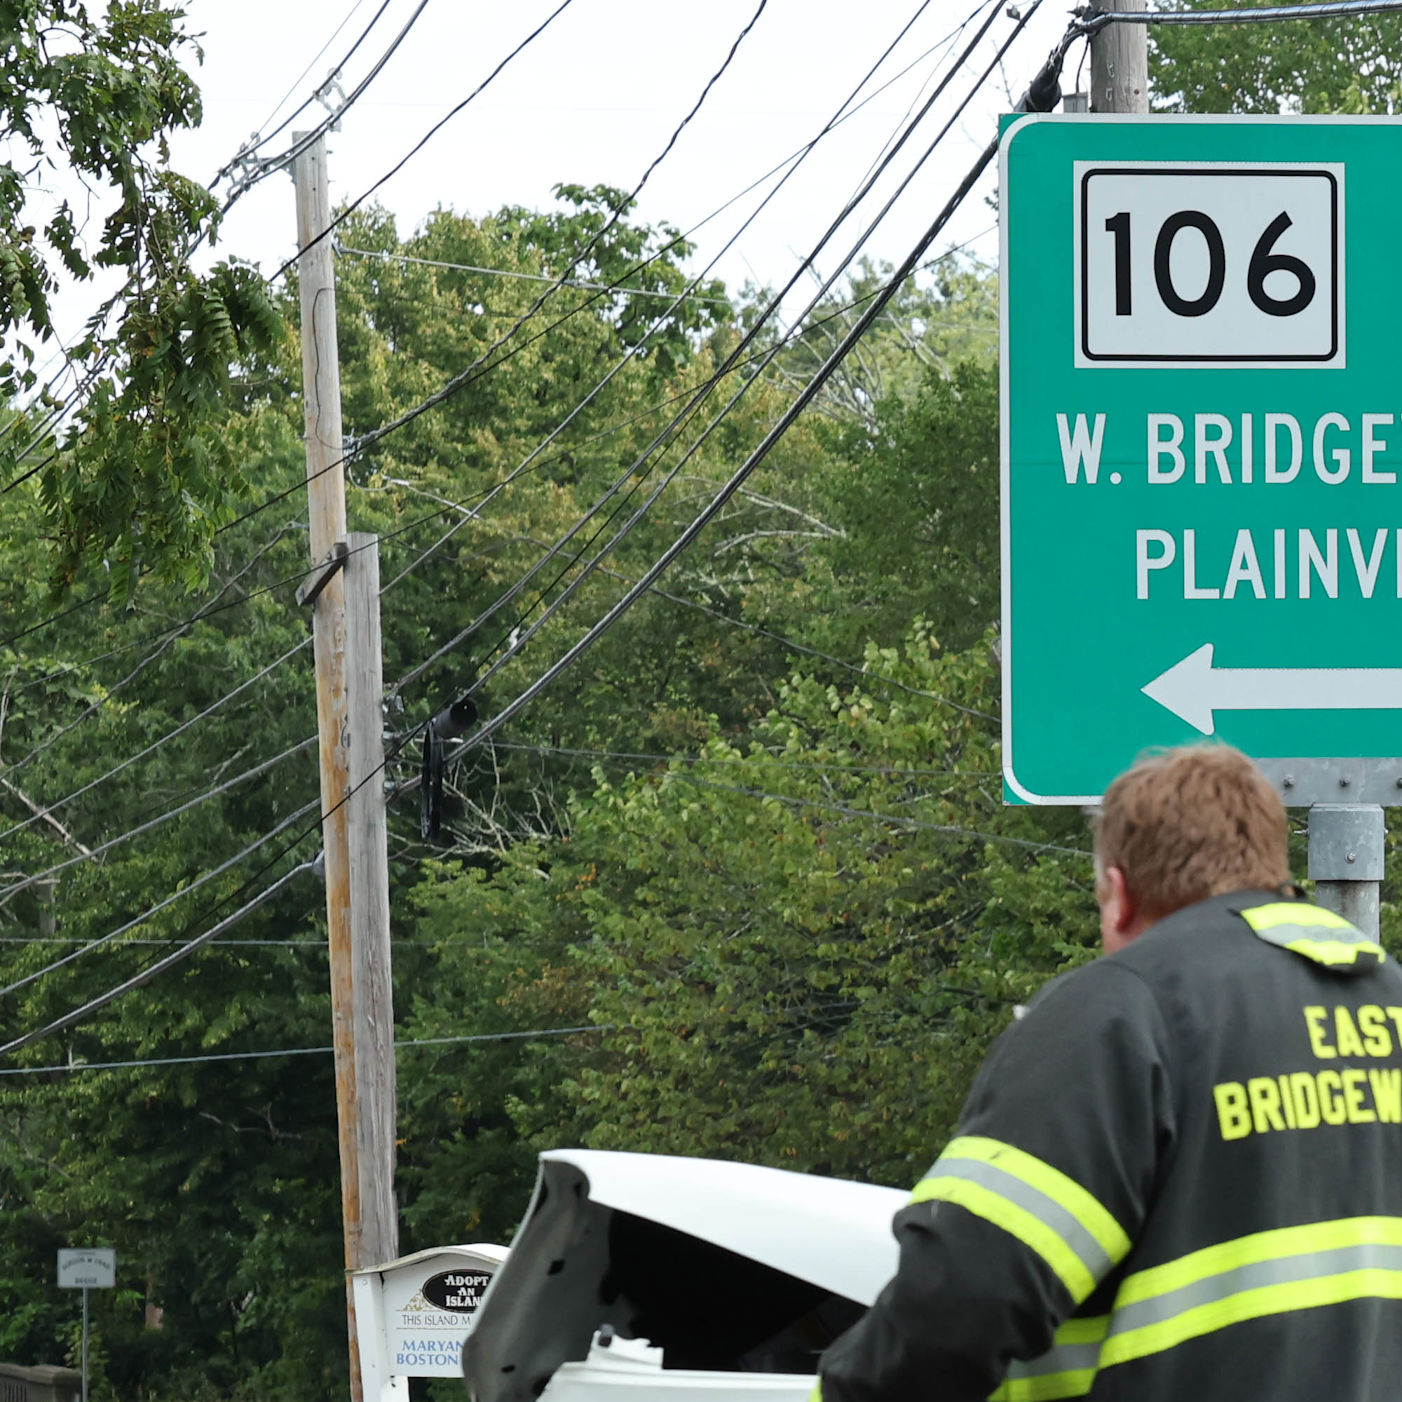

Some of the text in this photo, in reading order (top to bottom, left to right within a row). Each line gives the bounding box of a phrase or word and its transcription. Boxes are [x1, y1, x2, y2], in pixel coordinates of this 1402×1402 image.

[1105, 210, 1316, 318] 106
[1055, 413, 1122, 484] W.
[444, 1275, 489, 1287] ADOPT
[457, 1287, 475, 1296] AN
[445, 1295, 482, 1307] ISLAN
[402, 1314, 421, 1325] THIS
[424, 1314, 458, 1326] ISLAND
[402, 1340, 464, 1352] MARYAN
[397, 1353, 458, 1366] BOSTON
